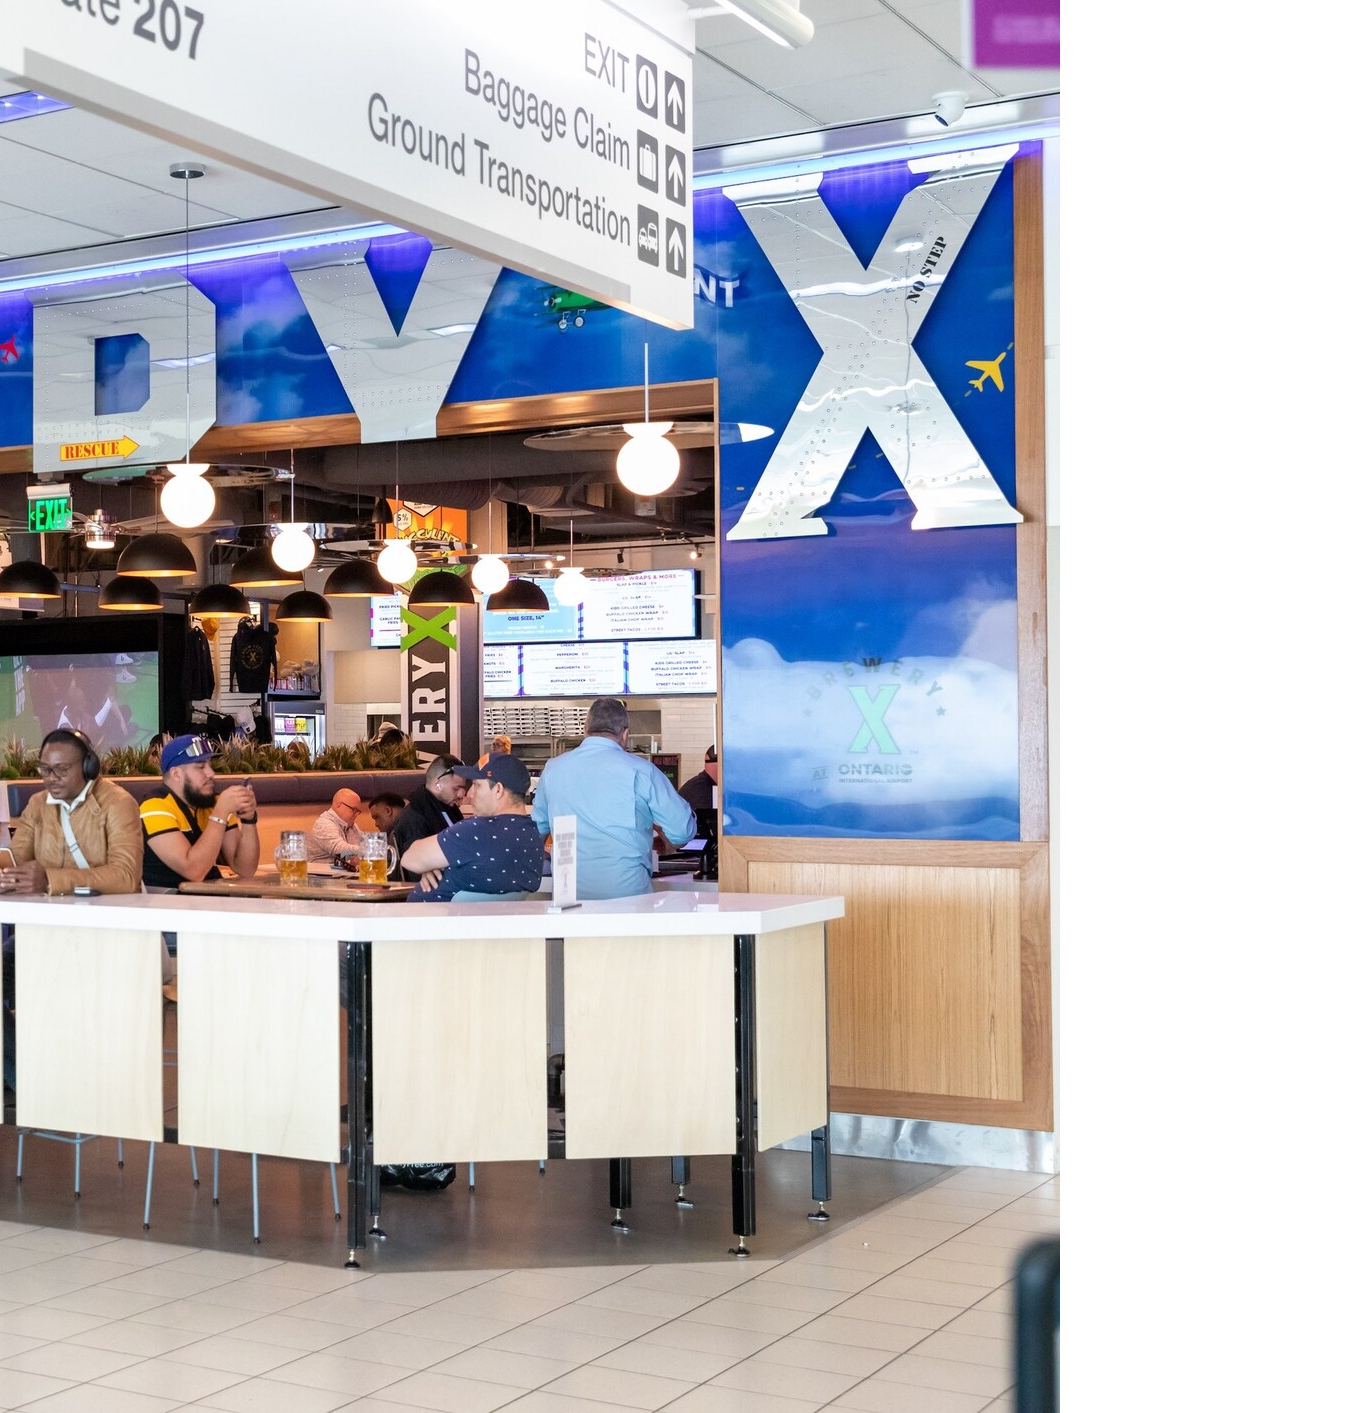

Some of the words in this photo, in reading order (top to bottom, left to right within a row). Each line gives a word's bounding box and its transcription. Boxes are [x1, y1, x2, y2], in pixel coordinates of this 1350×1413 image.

[133, 0, 204, 60] 207
[584, 32, 630, 95] EXIT
[464, 48, 567, 142] Baggage
[574, 107, 630, 170] Claim
[367, 92, 466, 176] Ground
[473, 138, 632, 247] Transportation
[906, 281, 926, 304] NO
[920, 236, 947, 278] STEP
[722, 144, 1024, 541] X
[65, 442, 119, 459] RESCUE
[36, 499, 68, 530] EXIT
[806, 656, 943, 701] BREWERY
[847, 684, 902, 755] X
[838, 763, 913, 776] ONTARIO
